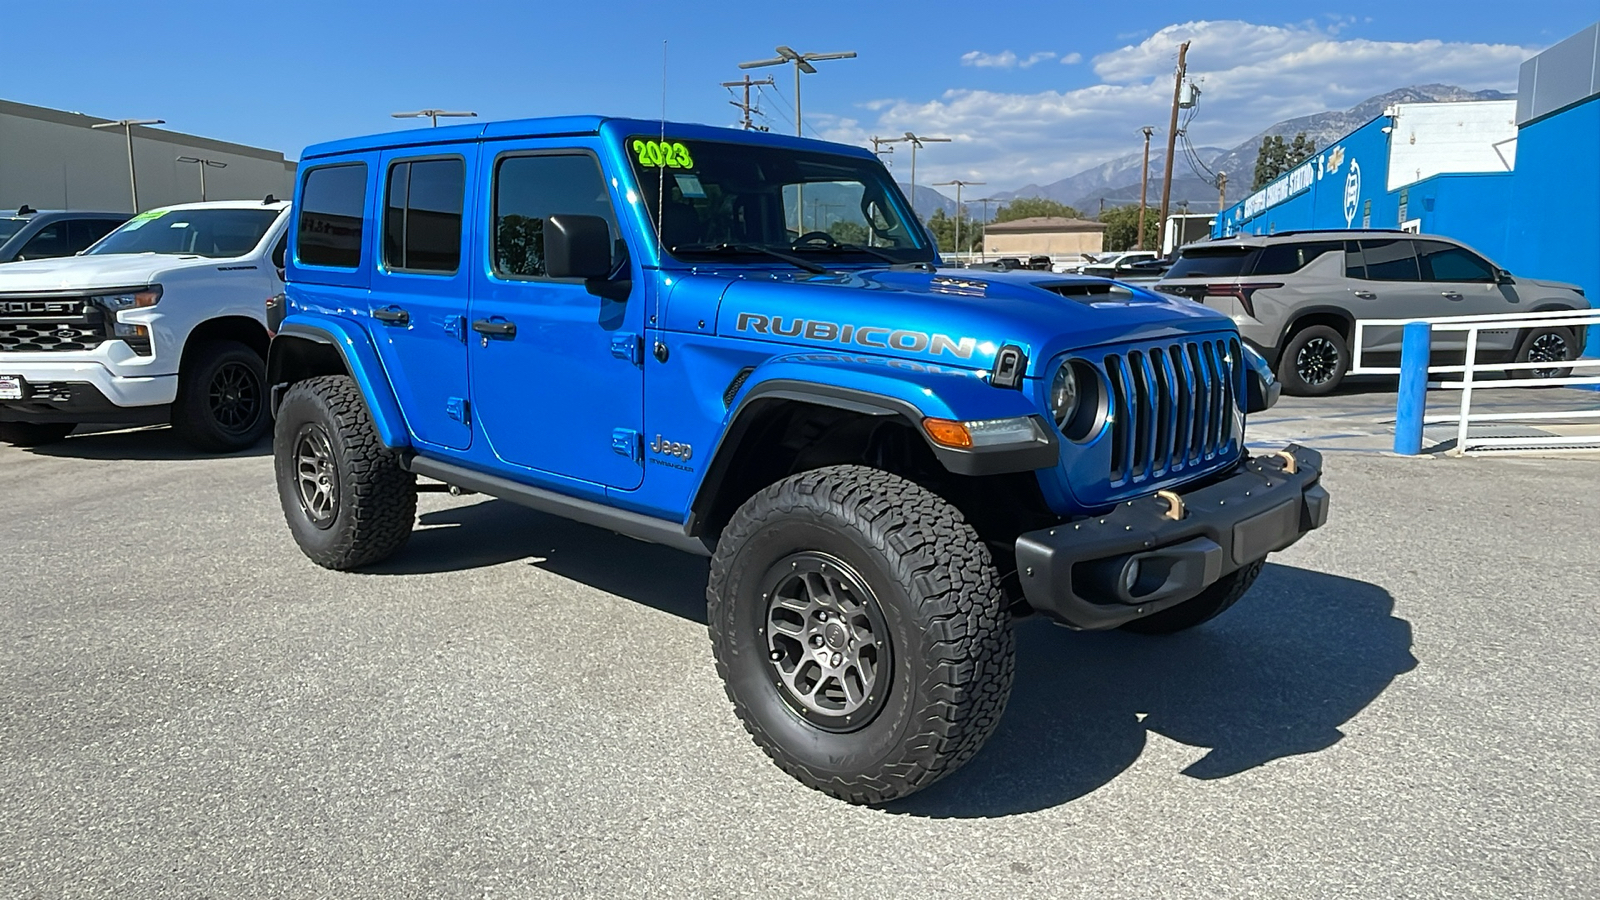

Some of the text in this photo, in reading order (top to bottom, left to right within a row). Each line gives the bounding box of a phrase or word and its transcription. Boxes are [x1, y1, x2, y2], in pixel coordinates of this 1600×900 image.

[633, 140, 694, 169] 2023
[736, 312, 977, 360] RUBICON
[650, 434, 693, 463] Jeep
